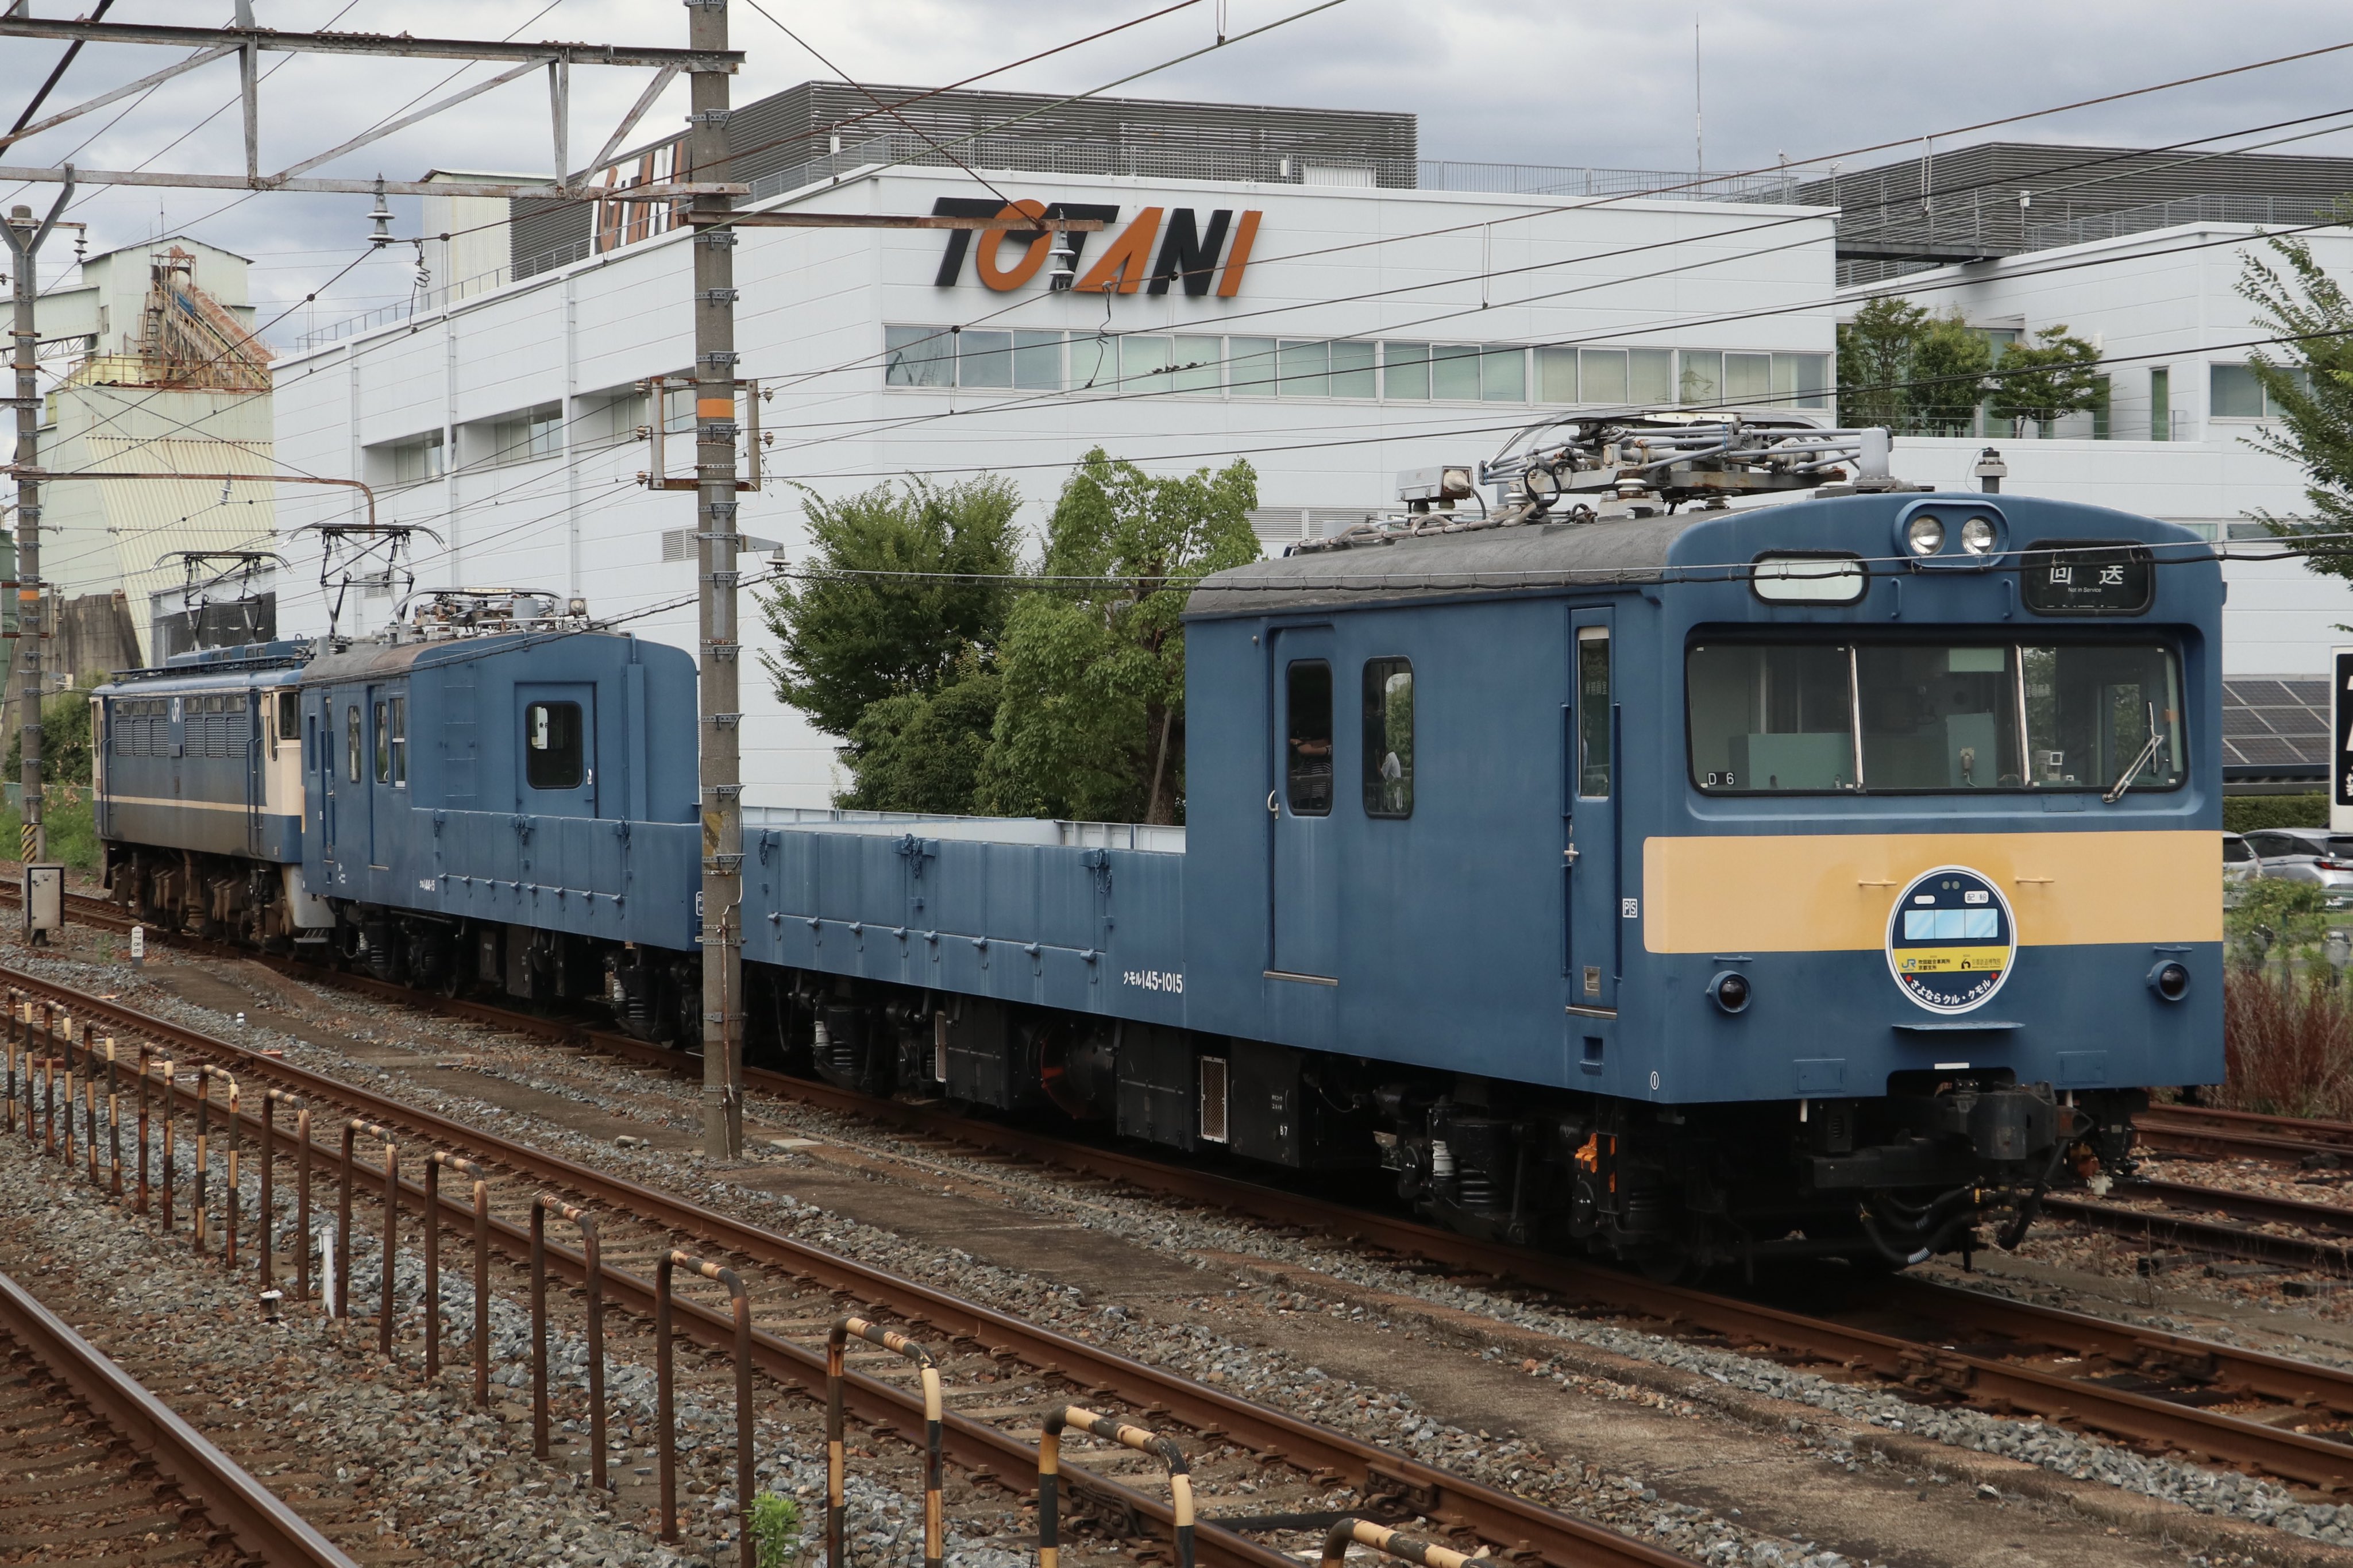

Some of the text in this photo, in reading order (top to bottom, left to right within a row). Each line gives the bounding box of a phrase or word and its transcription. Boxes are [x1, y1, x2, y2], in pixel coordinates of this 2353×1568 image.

[931, 197, 1263, 297] TOTANI
[2050, 565, 2124, 585] 回送
[172, 697, 180, 723] JR
[133, 931, 141, 953] 1786
[1901, 959, 1916, 968] JR
[1123, 970, 1183, 994] クモル145-1015
